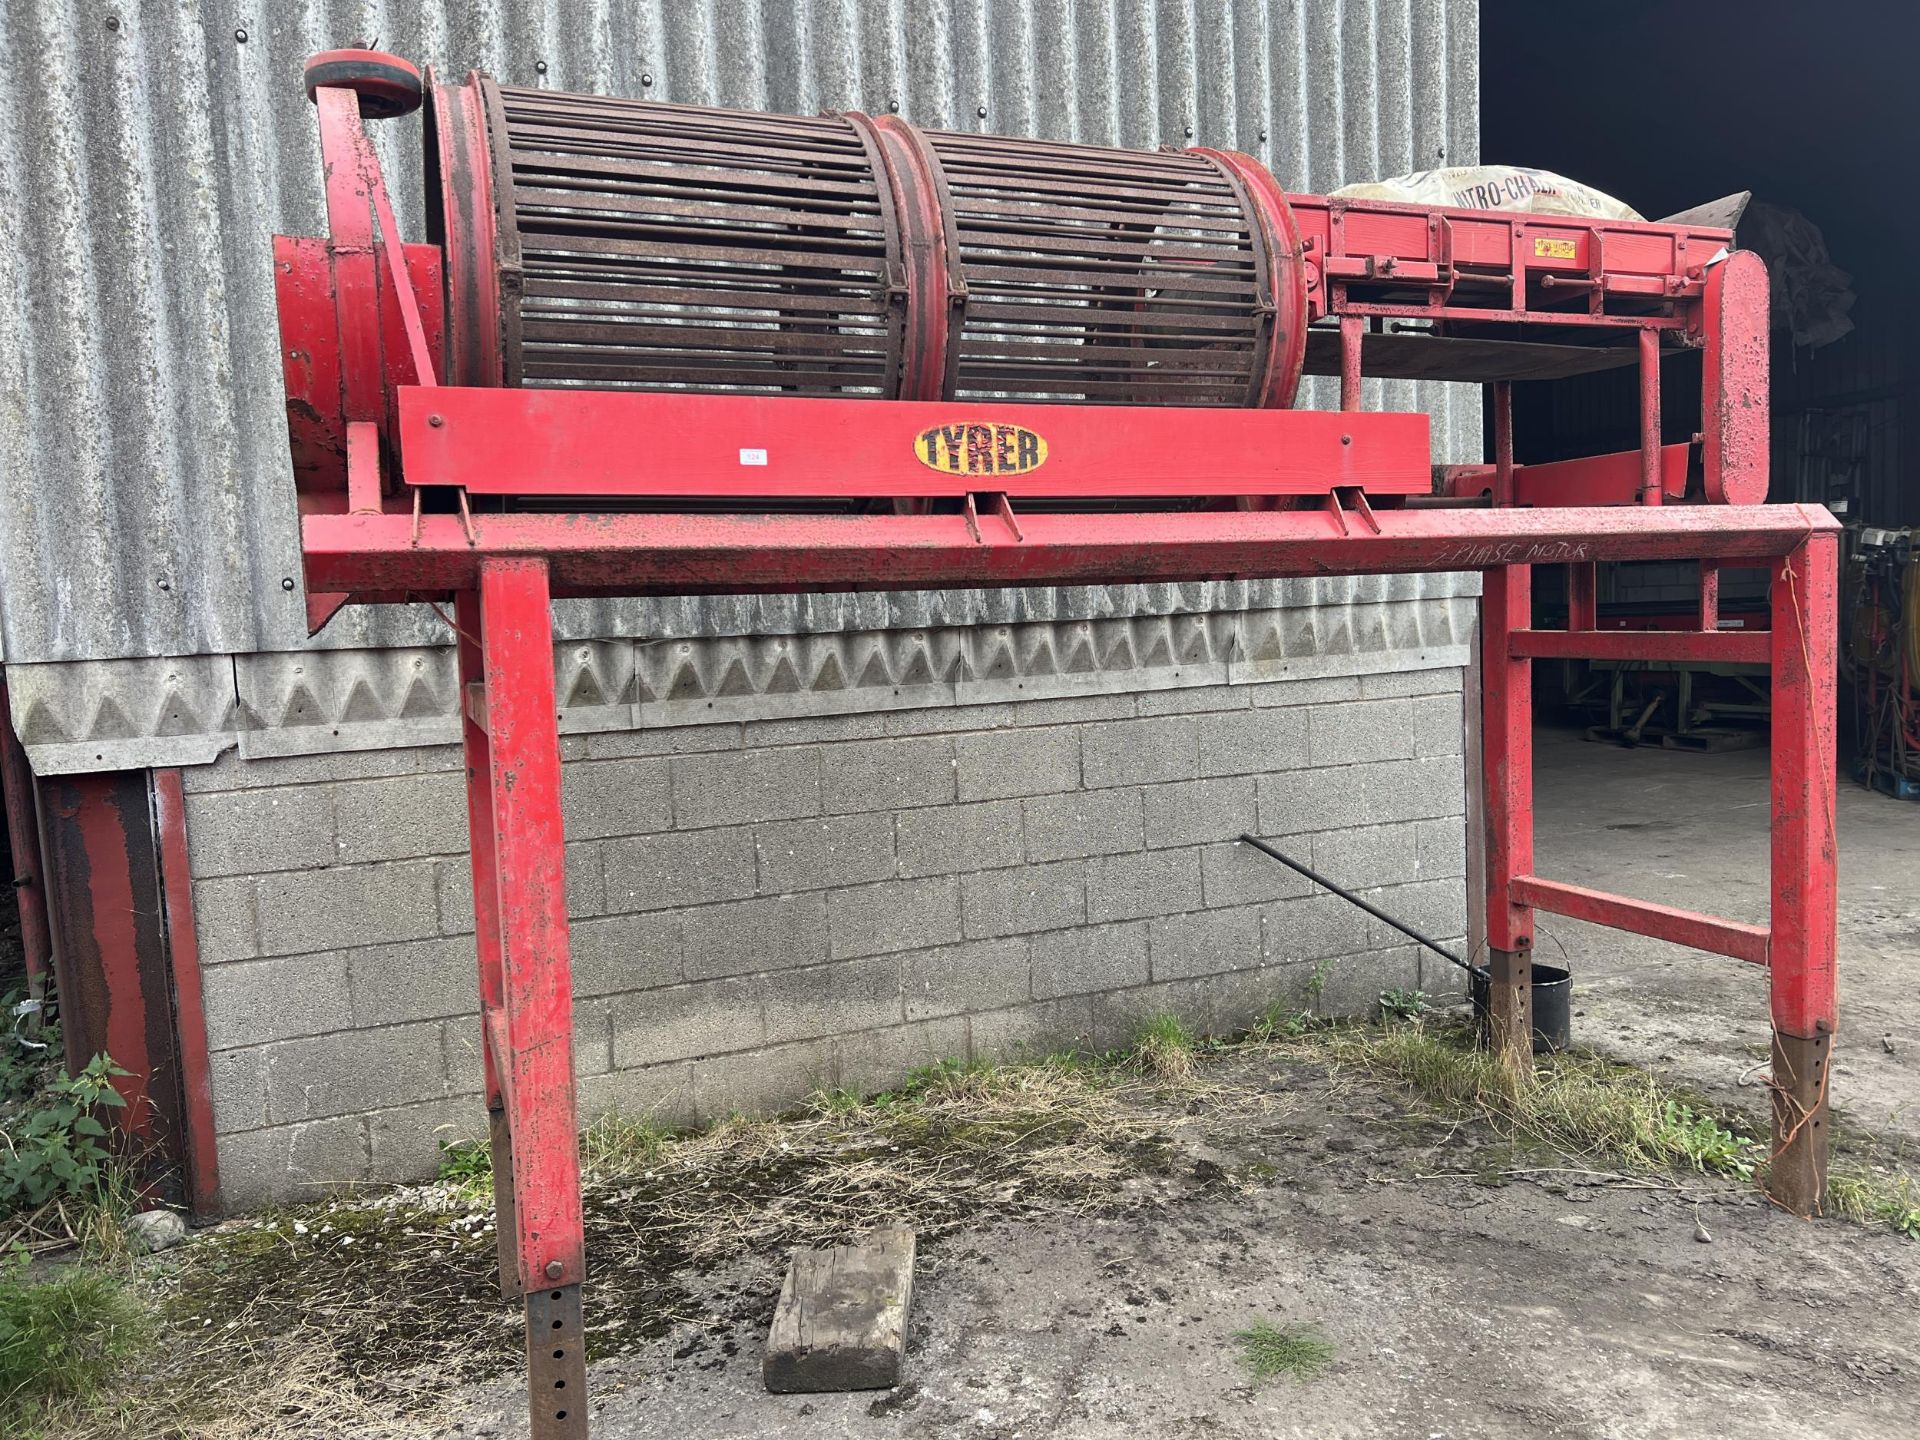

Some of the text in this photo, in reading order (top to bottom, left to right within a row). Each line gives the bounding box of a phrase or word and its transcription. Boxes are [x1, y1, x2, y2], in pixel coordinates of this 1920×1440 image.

[1452, 175, 1556, 209] NITRO-CHA
[921, 425, 1039, 472] TYRER
[1450, 542, 1520, 565] PHASE
[1525, 541, 1591, 560] MOTOR
